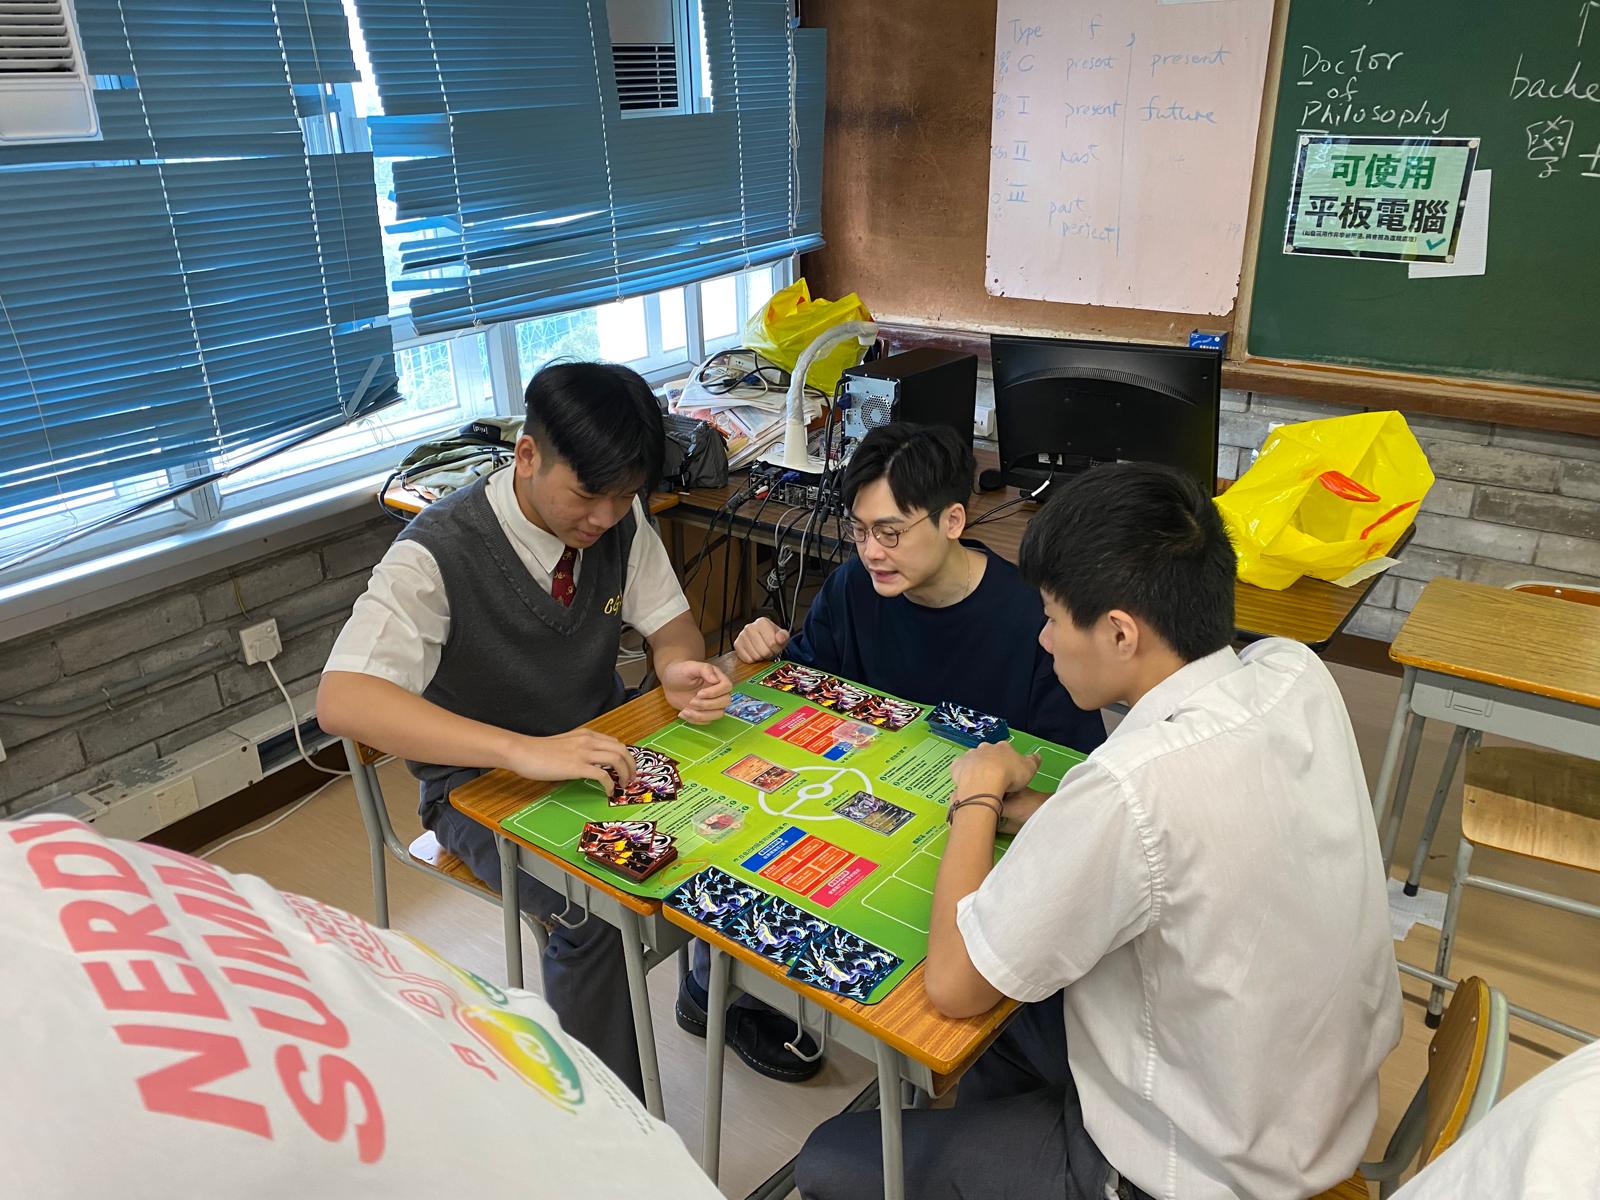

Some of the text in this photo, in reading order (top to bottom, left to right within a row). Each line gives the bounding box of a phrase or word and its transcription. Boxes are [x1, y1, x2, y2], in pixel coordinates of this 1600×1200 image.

[1008, 19, 1042, 46] Type
[1066, 56, 1118, 80] present
[1151, 46, 1232, 77] present
[1302, 44, 1404, 78] Doctor
[1509, 53, 1600, 102] bache
[1327, 76, 1359, 101] of
[1064, 101, 1123, 128] present
[1138, 95, 1218, 124] future
[1301, 100, 1450, 135] Philosophy
[1330, 153, 1437, 190] 可使用
[1304, 195, 1450, 235] 平板電腦
